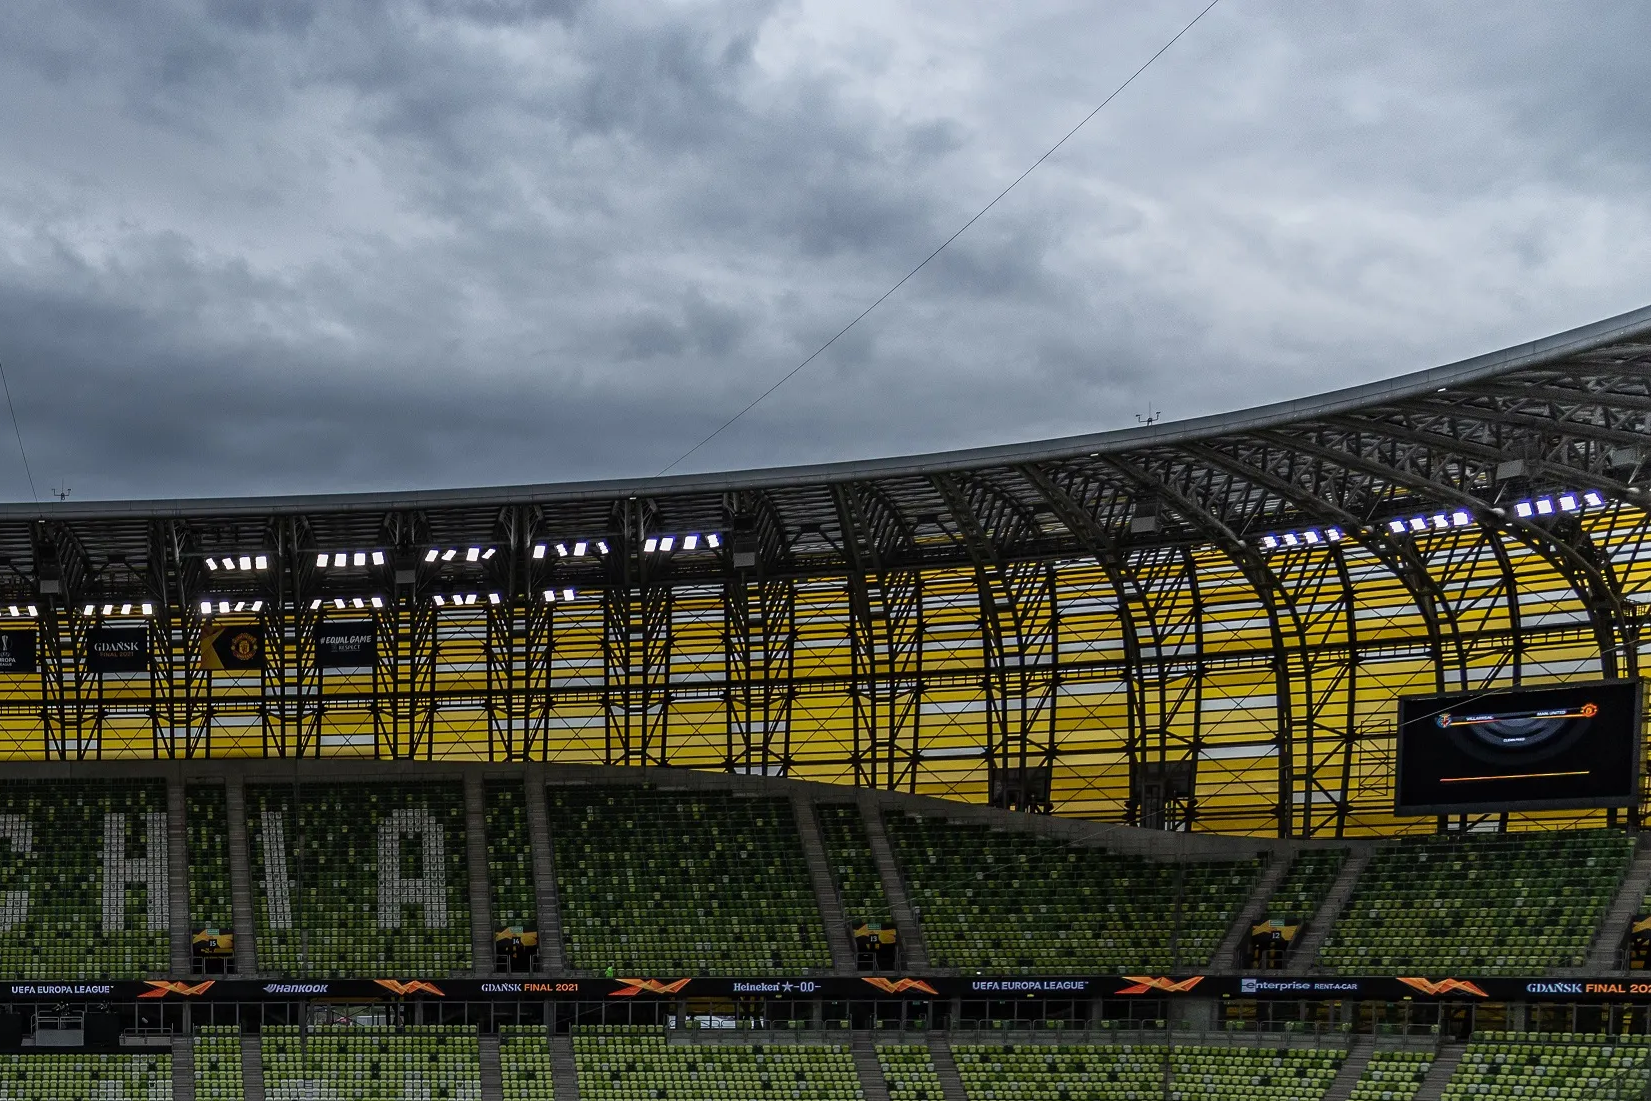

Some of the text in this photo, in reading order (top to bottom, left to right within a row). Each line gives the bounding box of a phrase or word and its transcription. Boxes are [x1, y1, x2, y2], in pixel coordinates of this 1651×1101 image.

[94, 641, 139, 651] GDAŃSK
[11, 985, 36, 993] UEFA
[37, 985, 74, 993] EUROPA
[481, 983, 579, 992] GDAŃSK FINAL 2021
[733, 982, 780, 992] Heineken
[972, 981, 1000, 990] UEFA
[1001, 981, 1042, 990] EUROPA
[1241, 979, 1310, 993] enterprise
[1527, 981, 1651, 993] GDAŃSK FINAL 202
